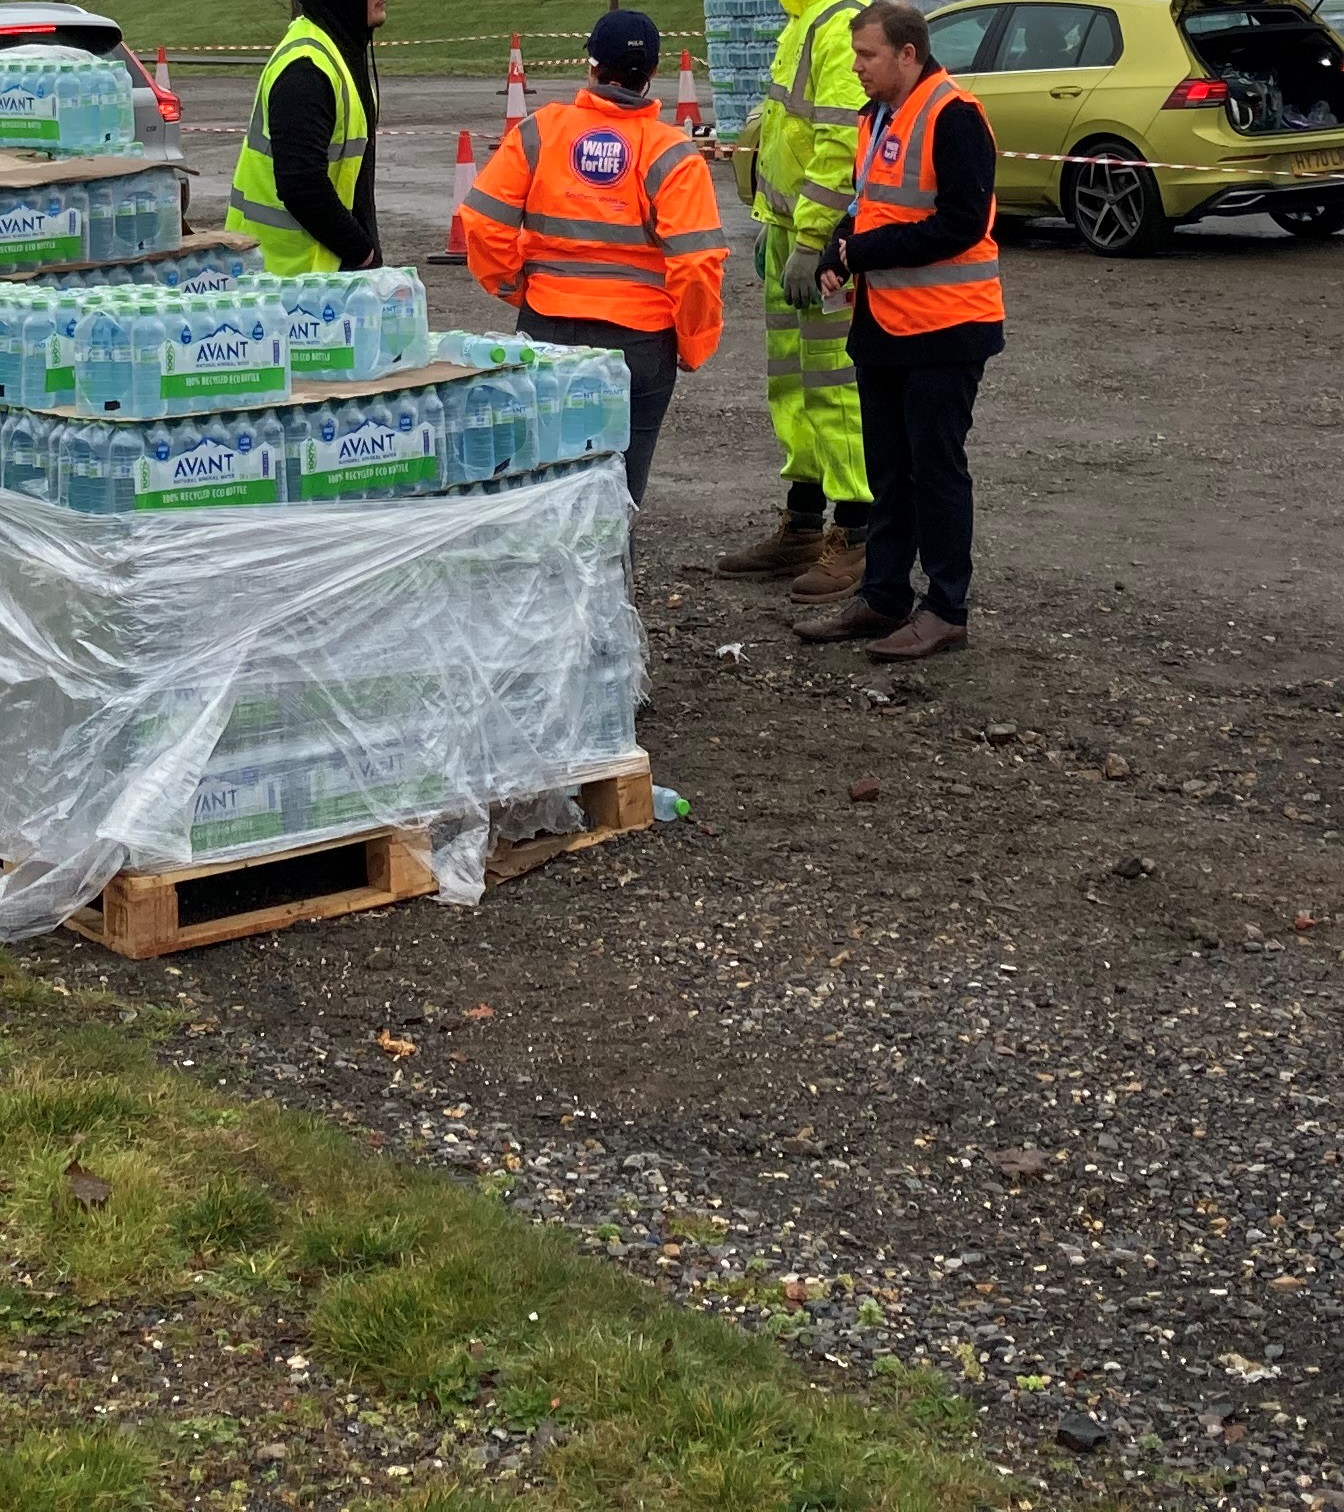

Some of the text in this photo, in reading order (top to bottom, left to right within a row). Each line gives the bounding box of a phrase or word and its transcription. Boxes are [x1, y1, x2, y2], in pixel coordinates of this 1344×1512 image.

[582, 140, 622, 157] WATER
[183, 277, 230, 294] AVANT
[289, 322, 321, 338] ANT
[196, 341, 249, 362] AVANT
[339, 433, 396, 458] AVANT
[174, 453, 234, 478] AVANT
[162, 485, 248, 504] 100% RECYCLED ECO BOTTLE
[195, 789, 238, 813] ANT
